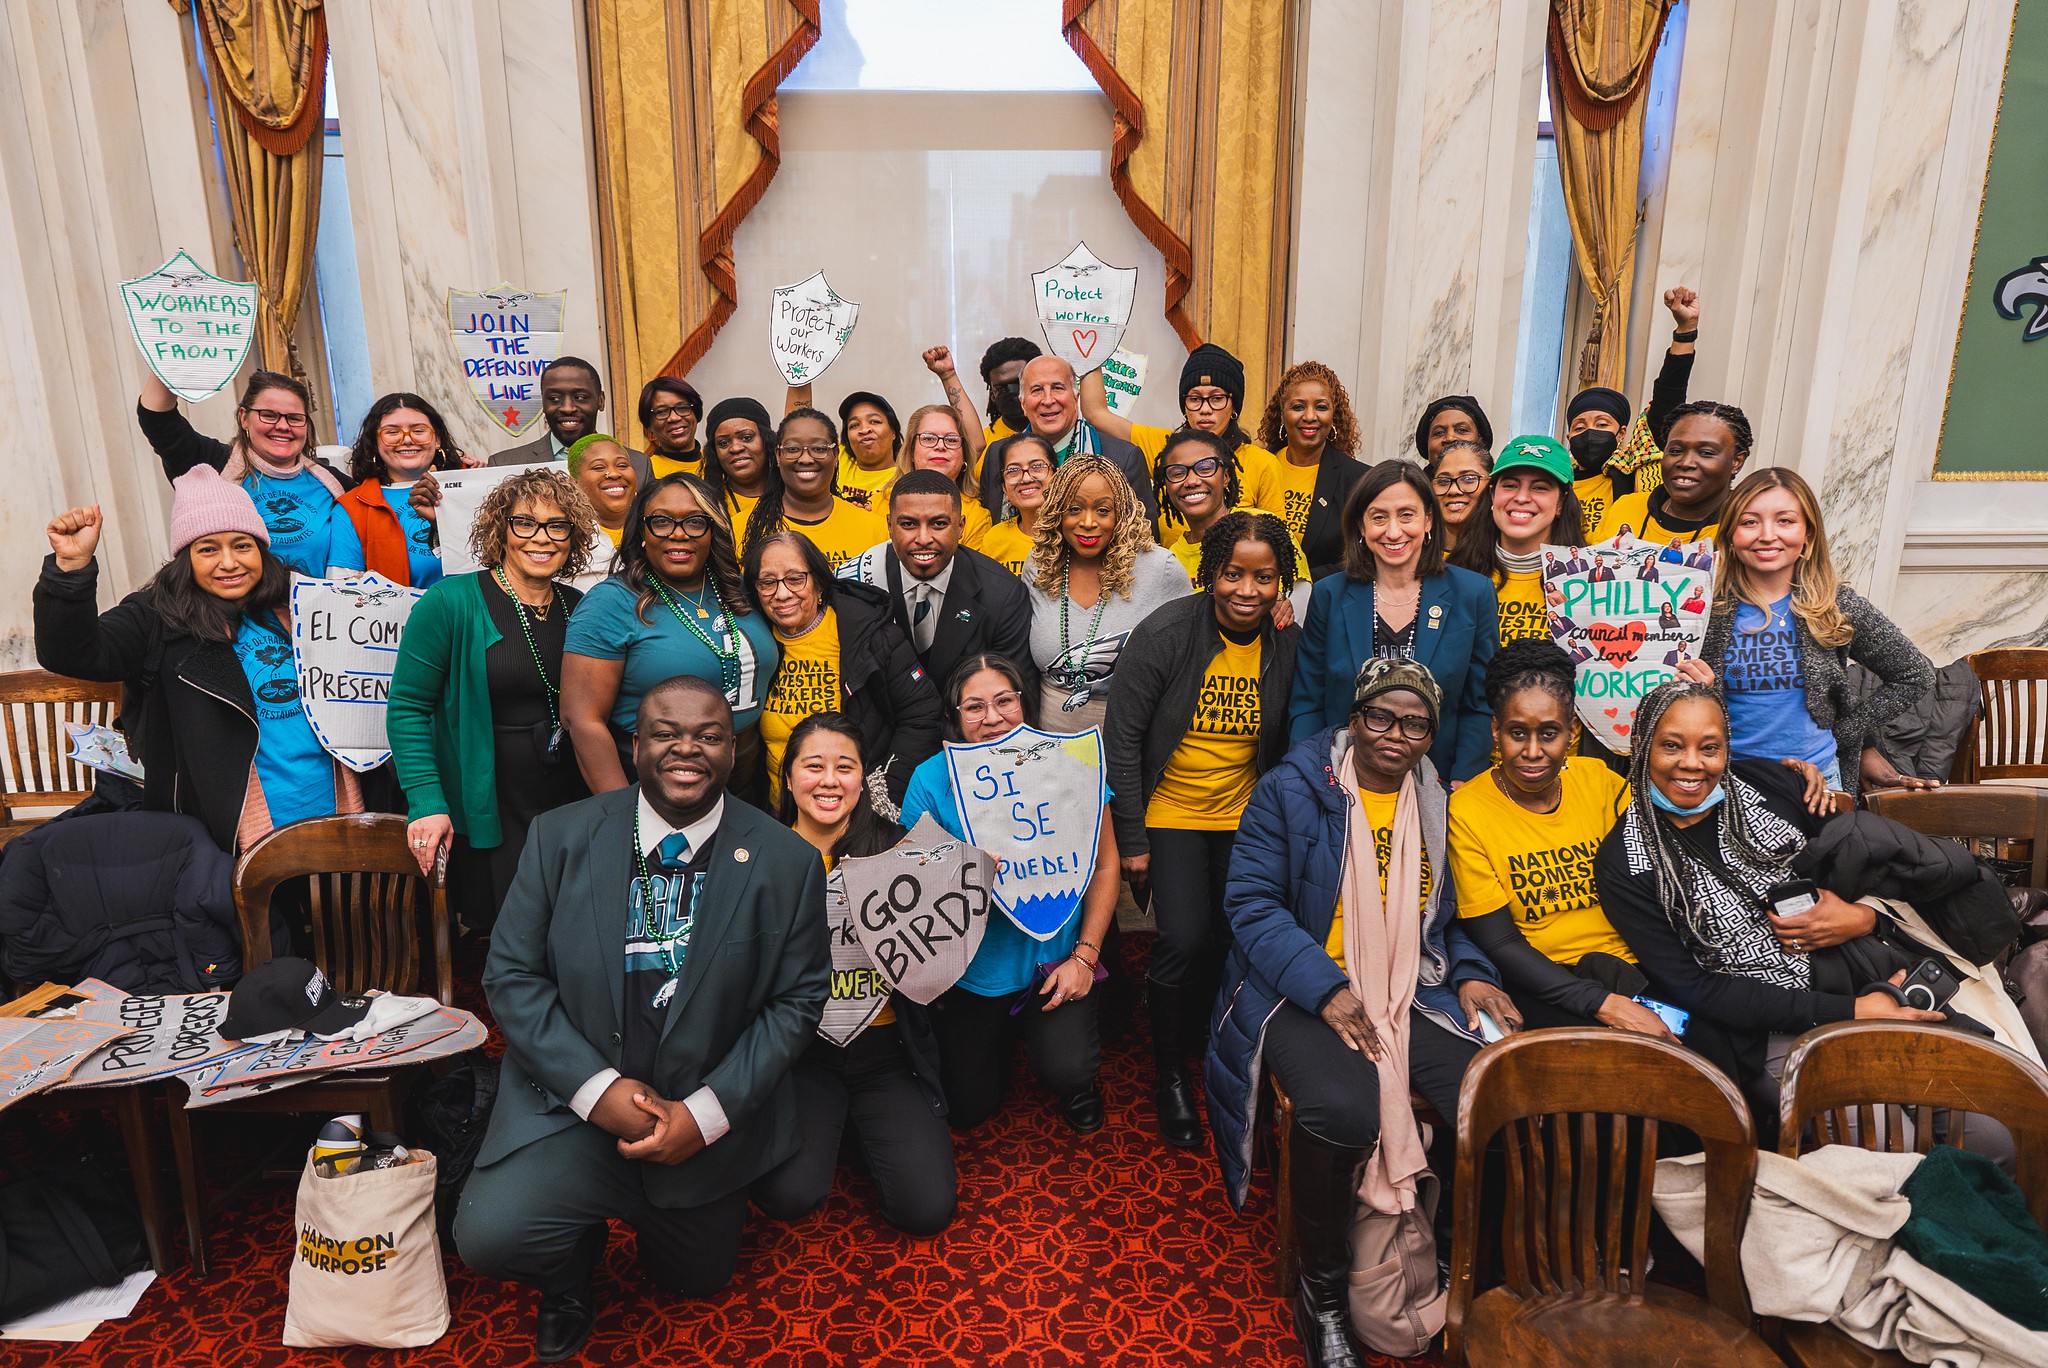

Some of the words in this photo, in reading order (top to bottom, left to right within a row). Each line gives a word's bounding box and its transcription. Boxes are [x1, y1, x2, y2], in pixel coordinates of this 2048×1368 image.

[1044, 279, 1103, 300] Protect
[132, 291, 251, 317] WORKERS
[150, 317, 184, 335] TO
[196, 321, 242, 336] THE
[464, 313, 530, 334] JOIN
[1055, 311, 1110, 323] workers
[790, 327, 814, 339] our
[154, 341, 239, 362] FRONT
[485, 336, 530, 355] THE
[776, 336, 824, 363] Workers
[487, 382, 534, 401] LINE
[271, 529, 314, 544] STAURANTES
[863, 571, 873, 584] RY
[1563, 577, 1691, 618] PHILLY
[311, 610, 337, 641] EL
[348, 616, 404, 645] COM
[1568, 624, 1628, 642] council
[1632, 627, 1700, 643] members
[1594, 646, 1638, 662] love
[782, 660, 833, 674] IONAL
[302, 666, 390, 700] ¡PRESEN
[1201, 690, 1260, 708] OMES
[973, 765, 1020, 800] SI
[1012, 801, 1055, 841] SE
[997, 852, 1078, 885] PUEDE!
[860, 874, 922, 931] GO
[875, 862, 988, 985] BIRDS
[831, 968, 891, 1001] WER
[301, 1222, 347, 1256] HAPPY
[355, 1232, 394, 1254] ON
[301, 1245, 387, 1275] PURPOSE
